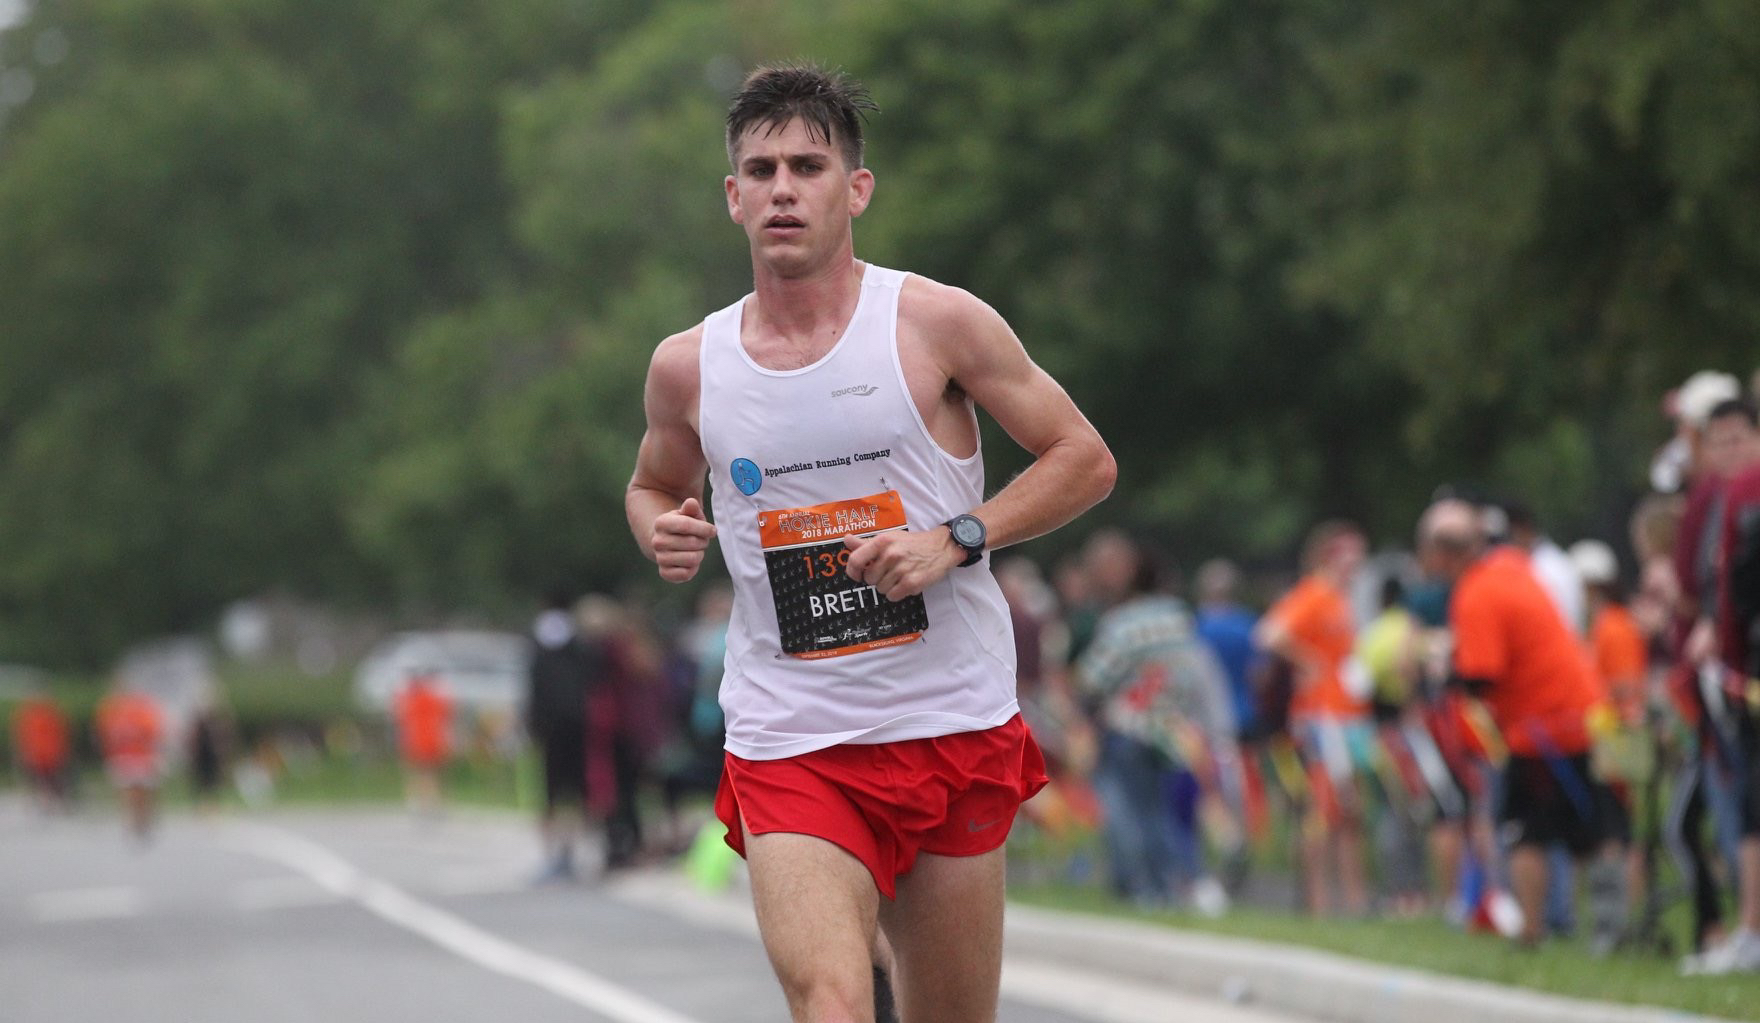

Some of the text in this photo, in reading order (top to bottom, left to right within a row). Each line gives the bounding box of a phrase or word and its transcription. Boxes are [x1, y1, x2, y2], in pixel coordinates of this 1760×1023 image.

[831, 384, 868, 398] saucony
[764, 448, 891, 477] Appalachian Running Company
[779, 505, 879, 533] HOKIE HALF
[802, 519, 876, 539] 2018 MARATHON
[809, 585, 880, 617] BRETT
